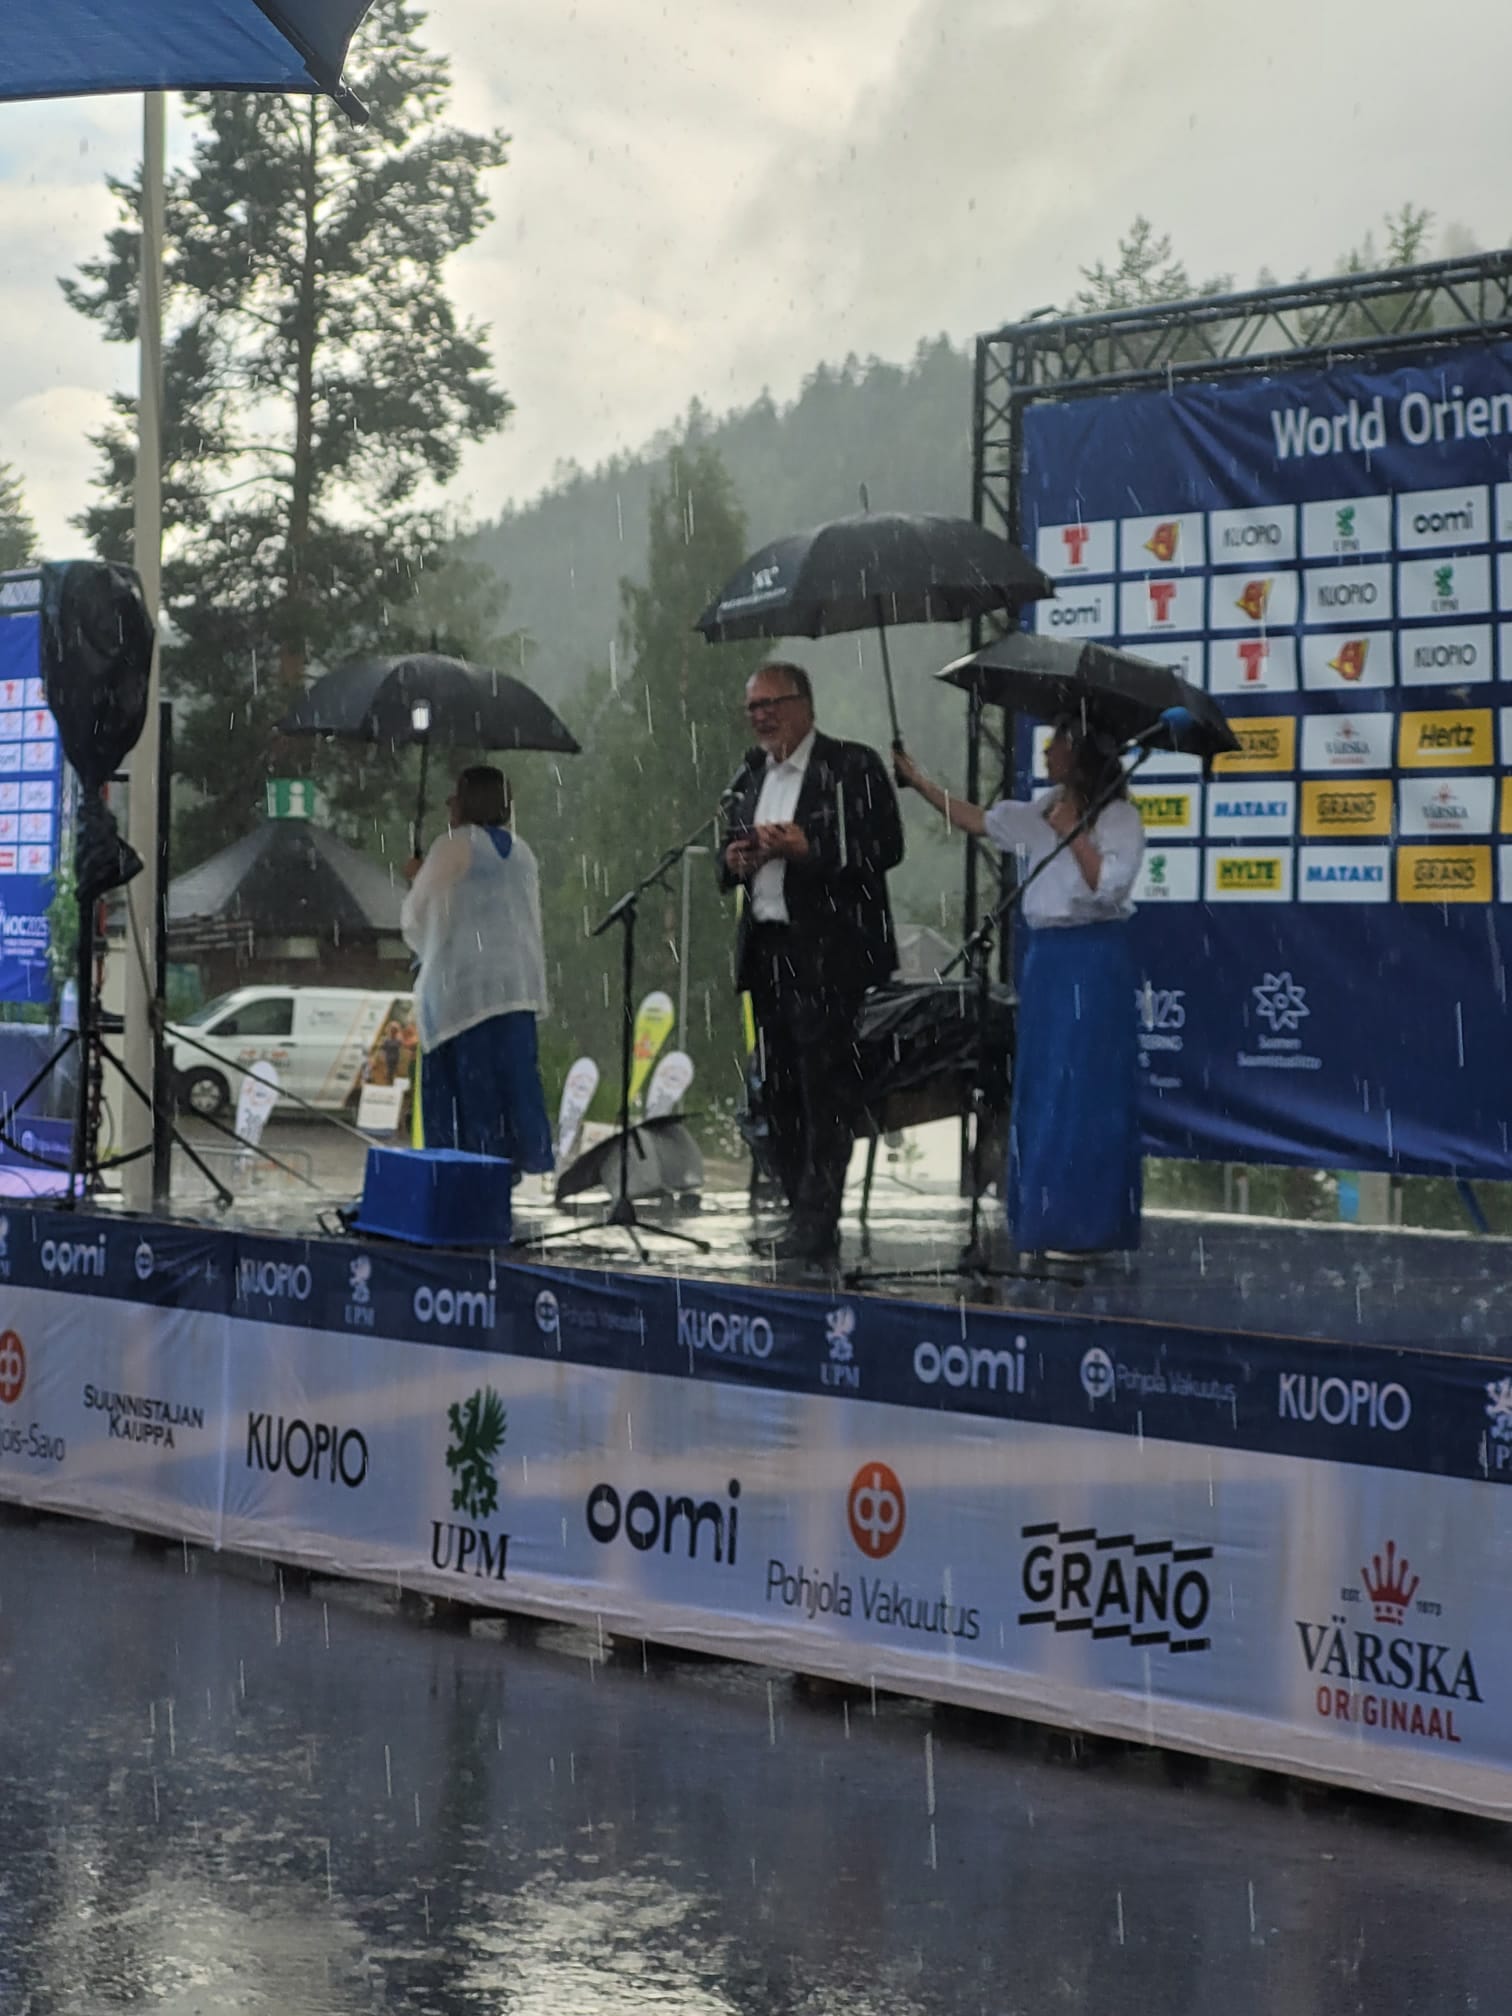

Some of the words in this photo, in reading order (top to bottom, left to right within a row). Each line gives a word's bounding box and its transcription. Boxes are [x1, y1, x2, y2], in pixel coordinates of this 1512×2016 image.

[1271, 395, 1386, 459] World
[1400, 385, 1512, 446] Orien
[1222, 523, 1282, 548] KUOPIO
[1414, 501, 1473, 533] oomi
[1051, 599, 1100, 626] oomi
[1318, 582, 1377, 607] KUOPIO
[1414, 643, 1477, 668] KUOPIO
[1420, 722, 1474, 747] Hertz
[1214, 802, 1287, 818] MATAKI
[1318, 799, 1376, 816] GRANO
[1221, 861, 1276, 880] HYLTE
[1307, 865, 1383, 883] MATAKI
[1415, 864, 1475, 882] GRANO
[41, 1233, 106, 1276] oomi
[240, 1257, 312, 1301] KUOPIO
[414, 1277, 496, 1329] oomi
[677, 1305, 774, 1358] KUOPIO
[820, 1362, 860, 1388] UPM
[913, 1335, 1027, 1395] oomi
[83, 1383, 204, 1429] SUUNNISTAJAN
[1279, 1372, 1412, 1431] KUOPIO
[0, 1422, 66, 1462] ois-Savo
[108, 1414, 175, 1449] KAUPPA
[247, 1411, 368, 1488] KUOPIO
[586, 1478, 741, 1566] oomi
[430, 1520, 512, 1581] UPM
[767, 1559, 853, 1620] Pohjola
[858, 1573, 981, 1642] Vakuutus
[1022, 1544, 1211, 1631] GRANO
[1295, 1614, 1485, 1704] VÄRSKA
[1316, 1685, 1462, 1743] ORIGINAAL
